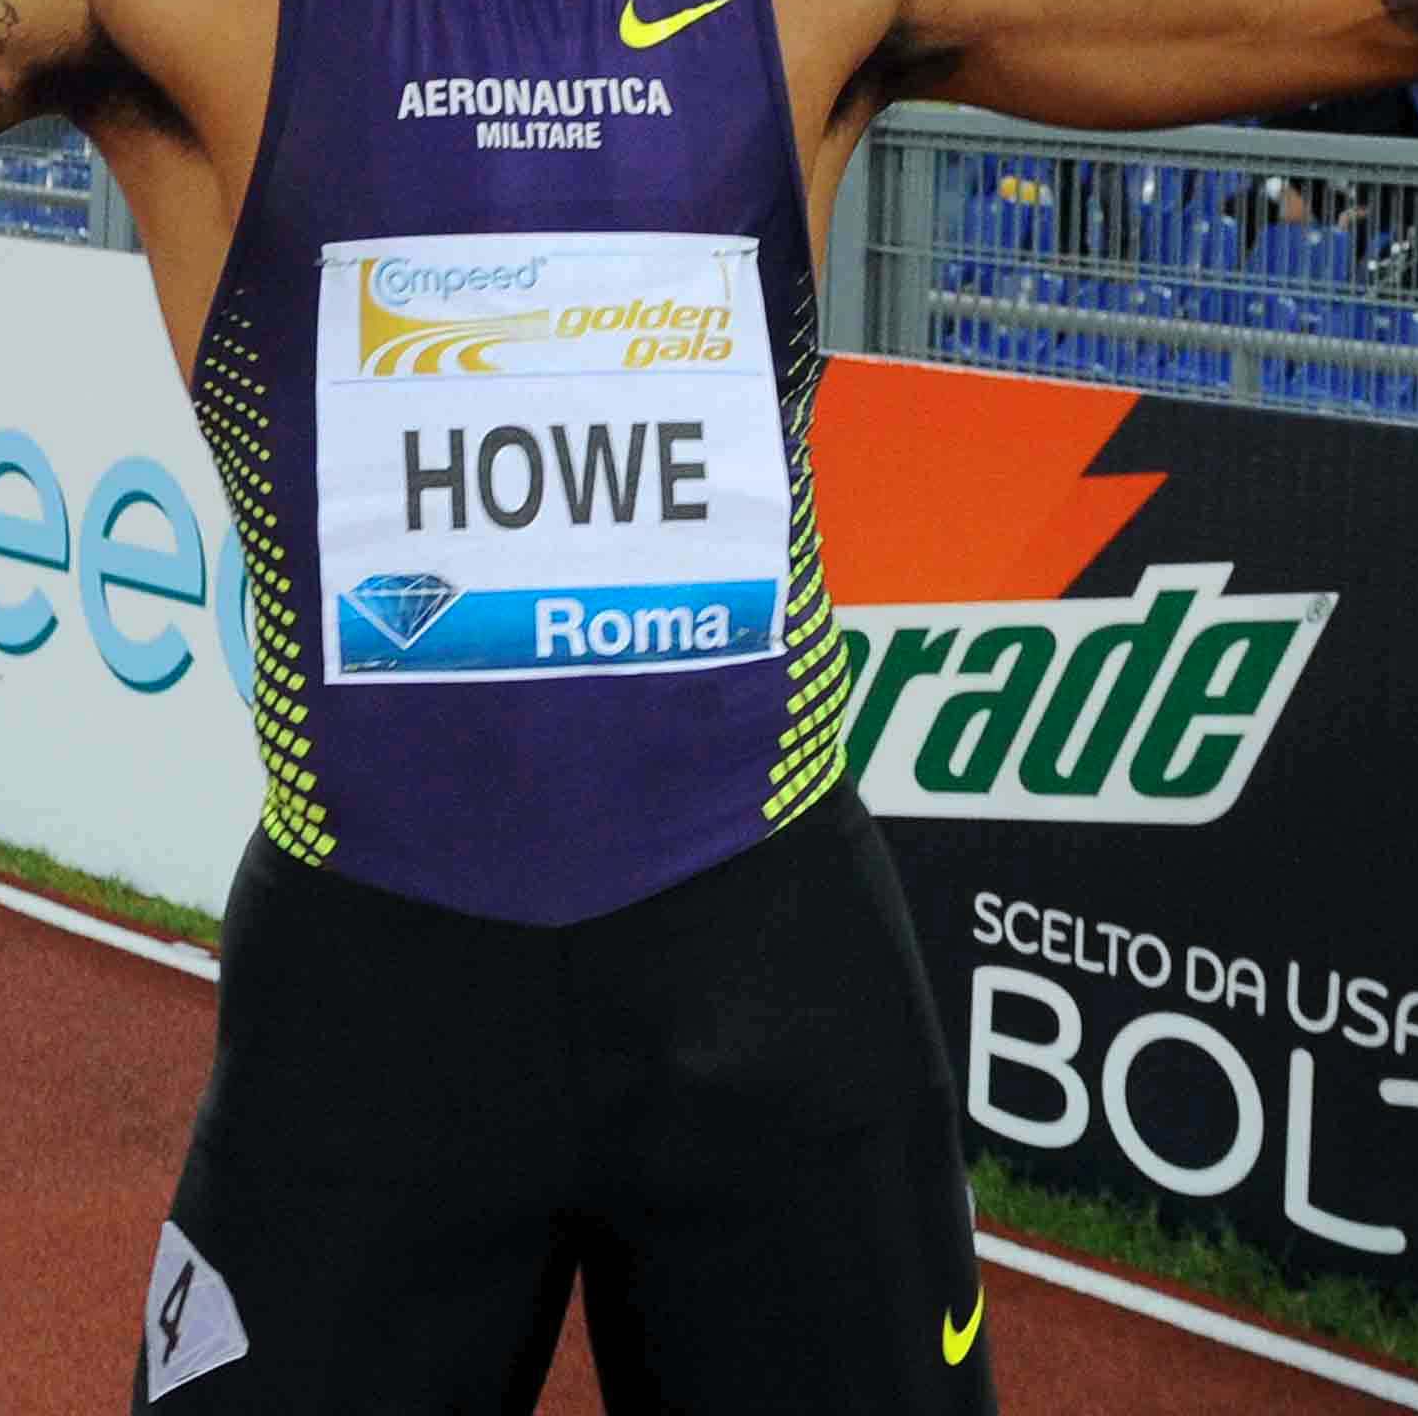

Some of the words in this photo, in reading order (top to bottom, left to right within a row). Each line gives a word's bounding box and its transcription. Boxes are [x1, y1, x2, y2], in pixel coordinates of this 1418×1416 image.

[397, 77, 672, 120] AERONAUTICA
[477, 121, 602, 150] MILITARE
[373, 256, 541, 306] Compeed
[554, 298, 732, 339] golden
[622, 329, 734, 369] gala
[403, 421, 709, 533] HOWE
[534, 597, 731, 660] Roma
[845, 589, 1302, 798] rade
[972, 891, 1171, 988] SCELTO
[1186, 945, 1266, 1016] DA
